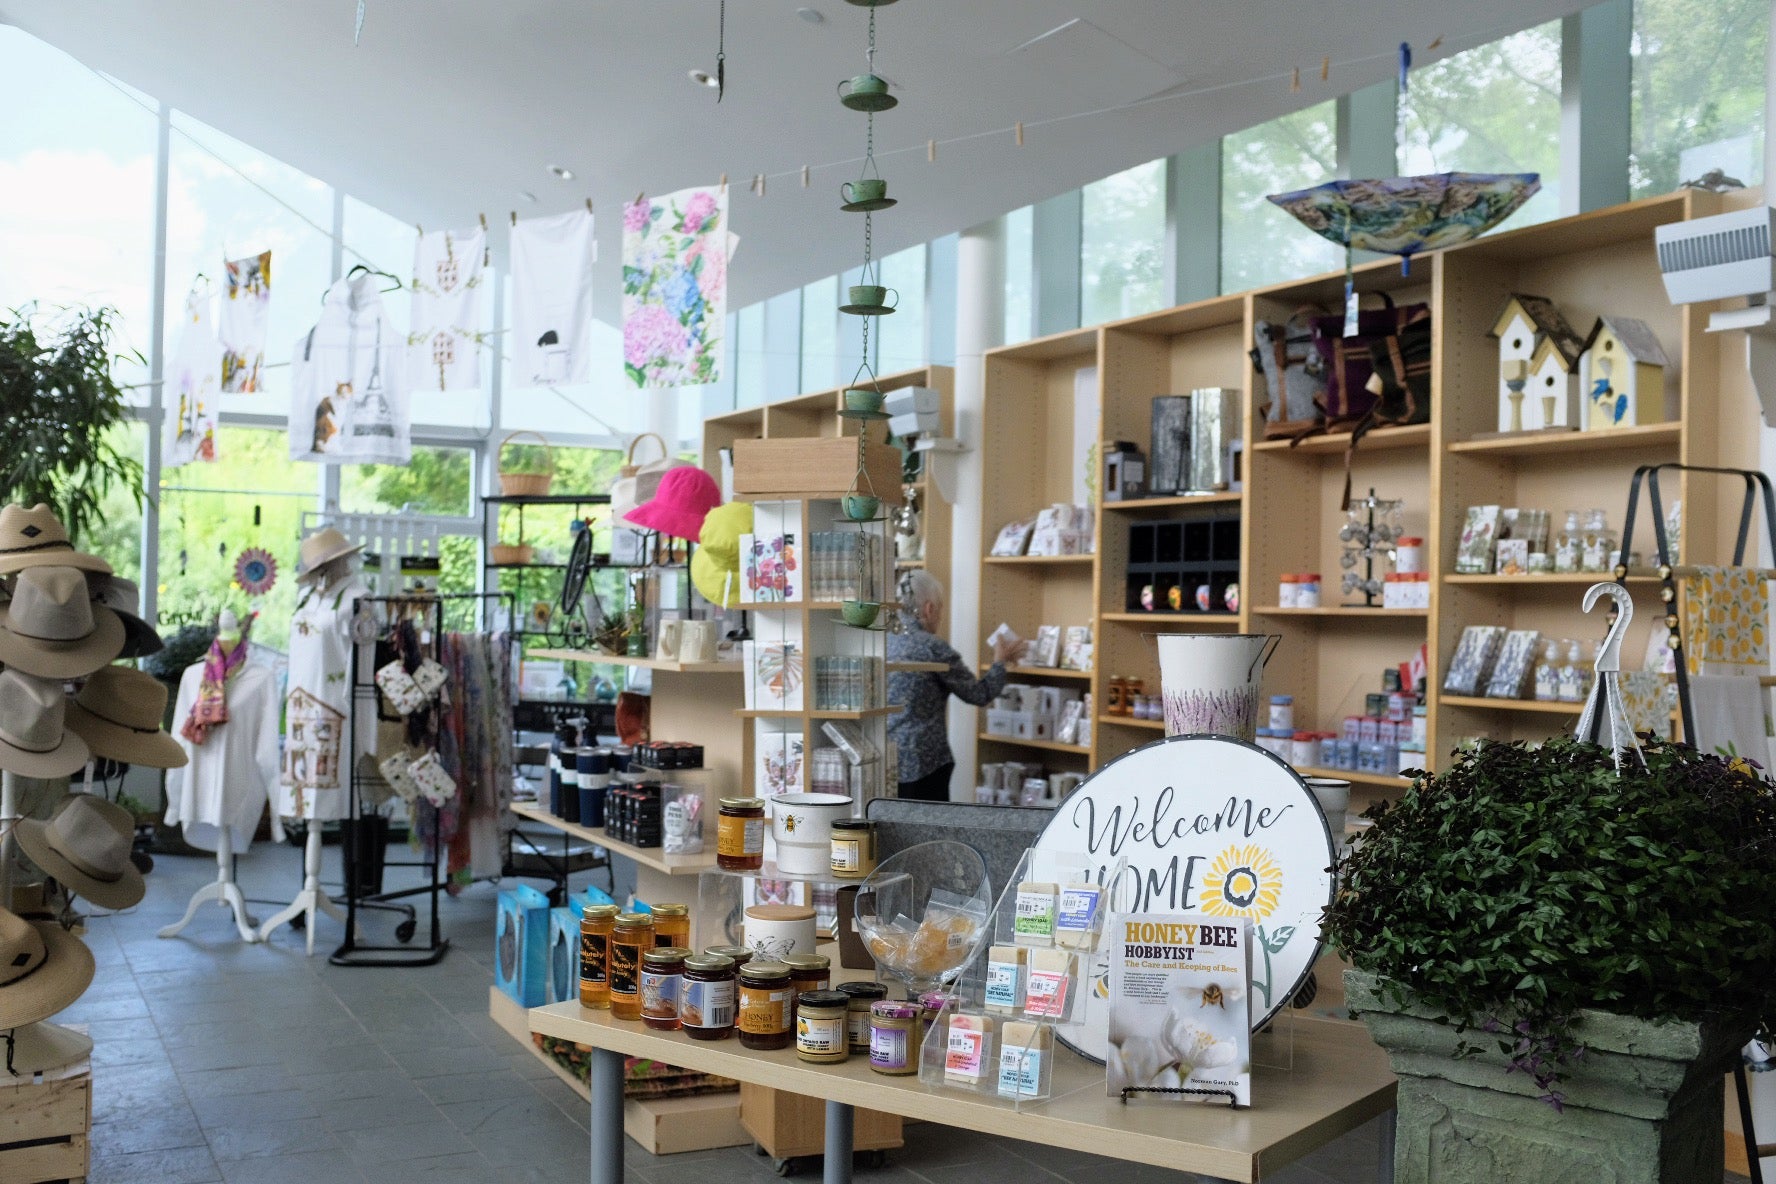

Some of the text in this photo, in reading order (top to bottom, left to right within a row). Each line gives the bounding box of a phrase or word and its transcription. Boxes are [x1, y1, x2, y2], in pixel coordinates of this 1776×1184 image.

[1072, 786, 1294, 857] Welcome
[1124, 922, 1237, 948] HONEY BEE
[1124, 945, 1195, 960] HOBBYIST
[1124, 960, 1140, 968] The
[1141, 961, 1161, 969] Care
[1162, 961, 1177, 969] and
[1179, 962, 1211, 973] Keeping
[1221, 964, 1238, 973] Bees
[744, 1011, 774, 1022] HONEY
